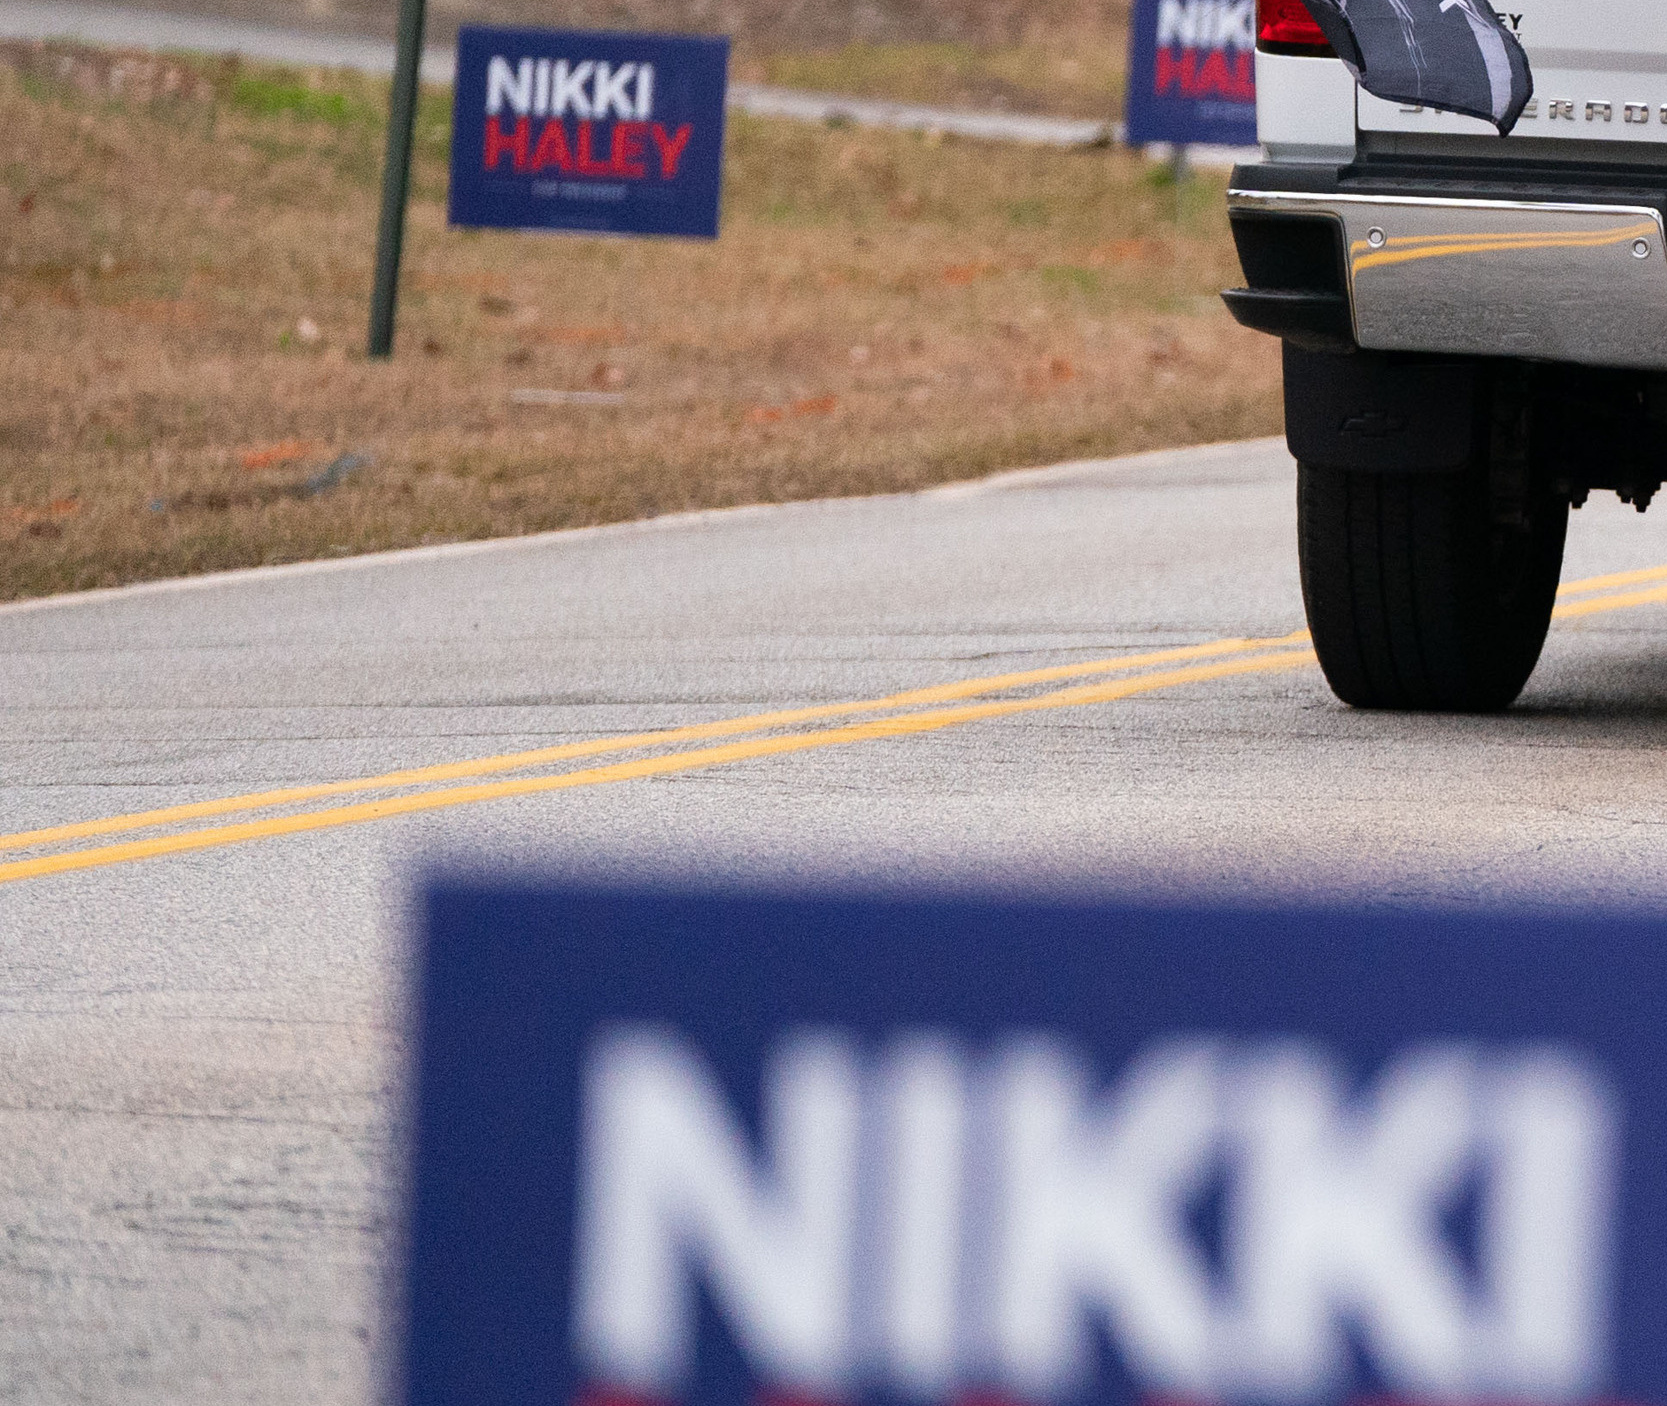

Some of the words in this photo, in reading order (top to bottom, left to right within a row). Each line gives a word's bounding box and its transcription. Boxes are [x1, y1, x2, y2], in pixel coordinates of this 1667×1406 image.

[486, 55, 654, 122] NIKKI
[1155, 46, 1256, 104] HAL
[483, 115, 693, 180] HALEY
[578, 1028, 1618, 1394] NIKKI
